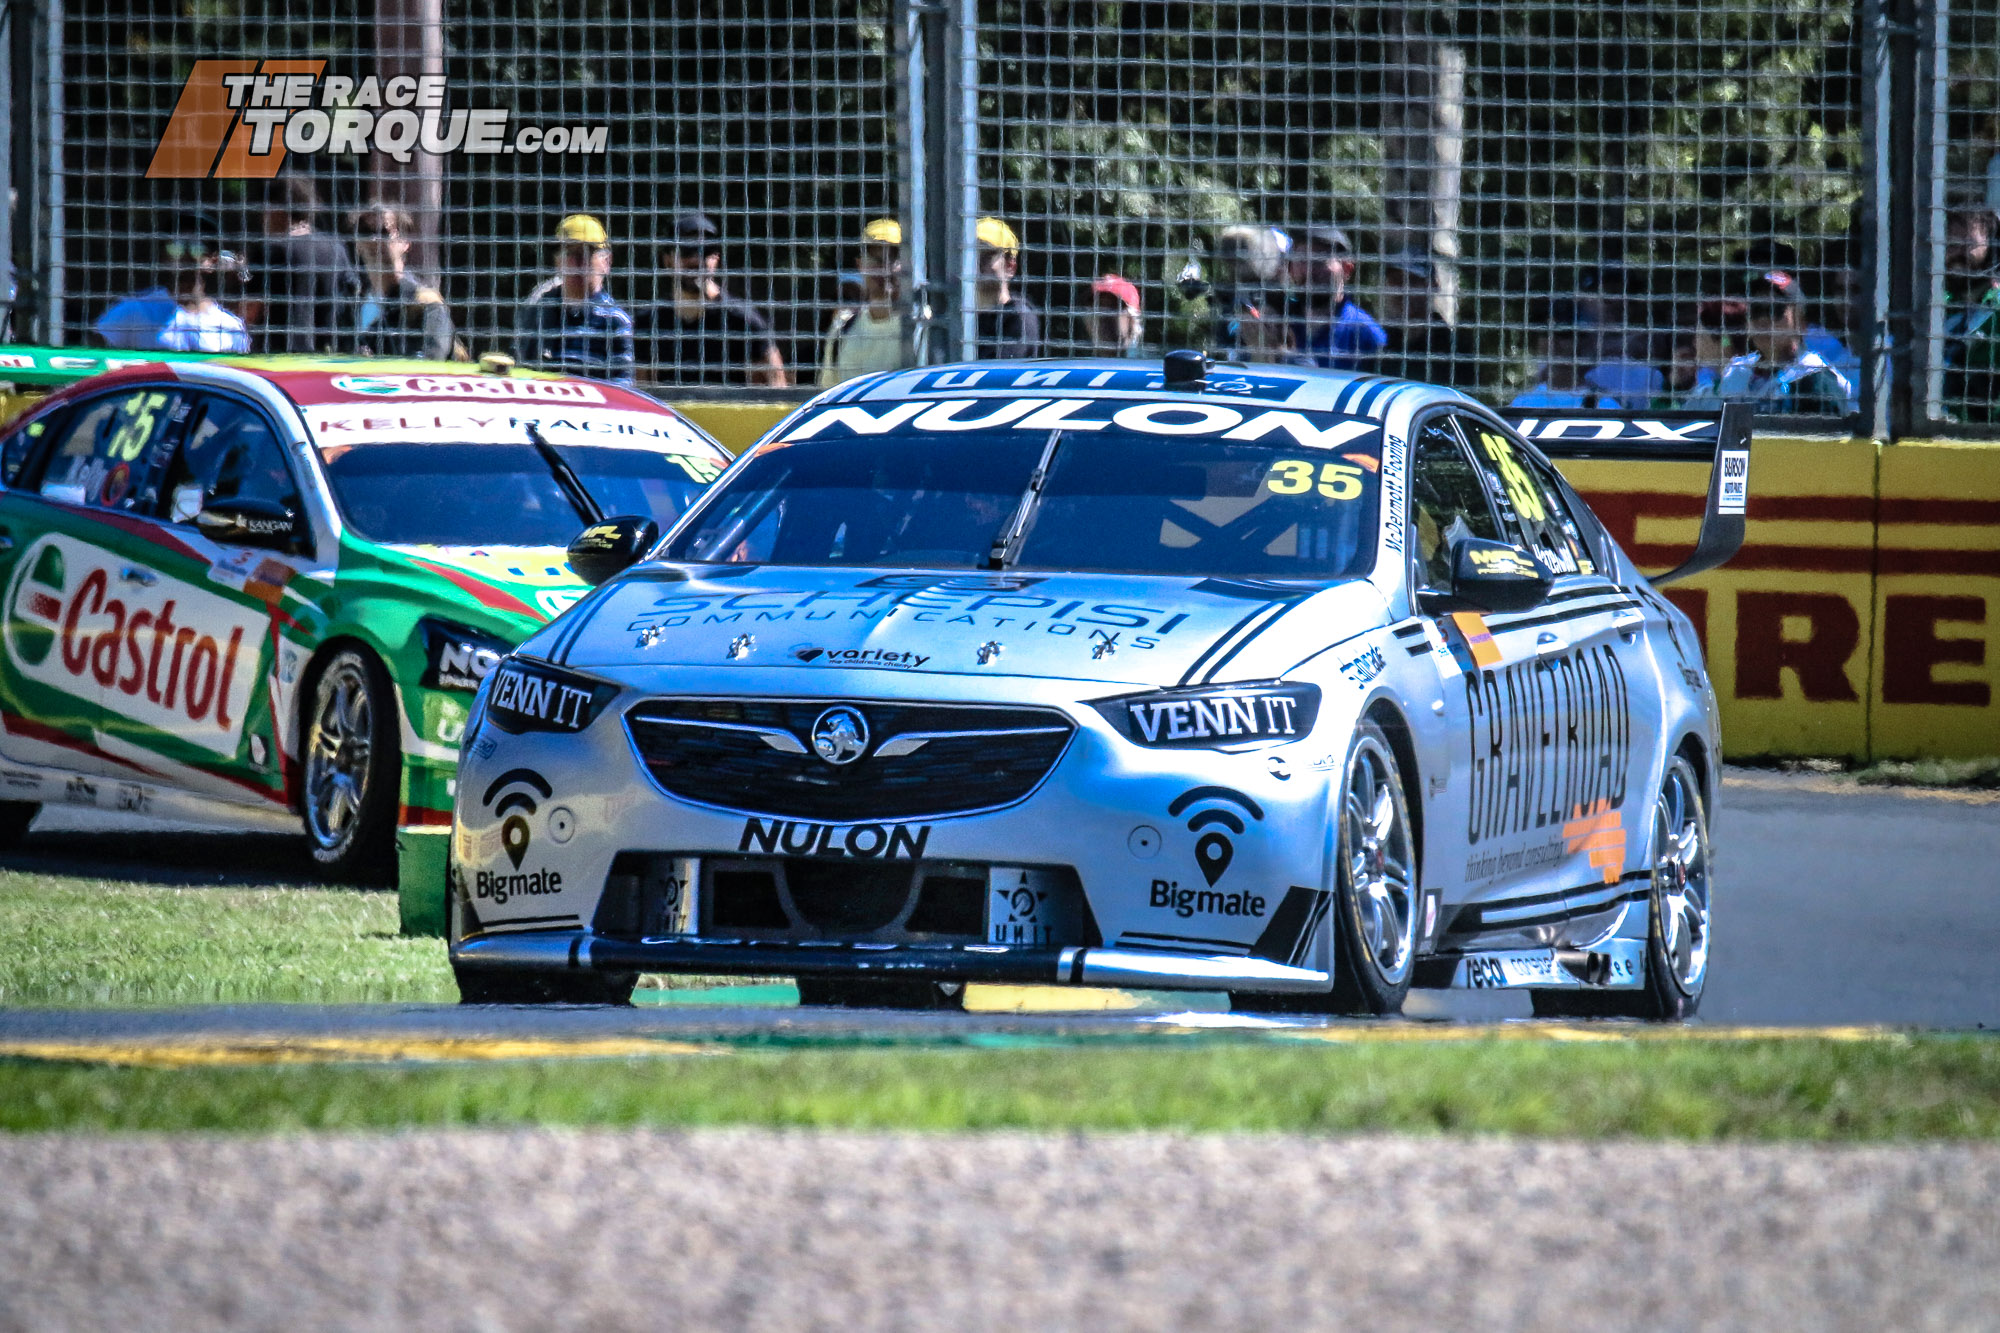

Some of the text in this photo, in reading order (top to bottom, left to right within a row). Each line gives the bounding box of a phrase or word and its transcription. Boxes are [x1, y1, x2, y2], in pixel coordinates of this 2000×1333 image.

[405, 378, 588, 400] Castrol
[107, 391, 168, 462] 15
[320, 416, 496, 433] KELLY
[508, 417, 695, 444] RACING
[779, 399, 1383, 450] NULON
[1267, 460, 1364, 500] 35
[1383, 434, 1408, 557] McDermott Flooring
[1480, 432, 1546, 521] 35
[625, 607, 1161, 650] COMMUNICATIONS
[637, 590, 1191, 634] SCHEPISI
[61, 568, 245, 732] Castrol
[826, 649, 930, 668] variety
[491, 668, 557, 720] VENN
[553, 684, 593, 729] IT
[1130, 696, 1297, 742] VENN IT
[1465, 644, 1630, 845] GRAVELROAD
[738, 817, 932, 860] NULON
[476, 868, 562, 904] Bigmate
[1150, 879, 1266, 918] Bigmate
[995, 924, 1052, 943] UNIT
